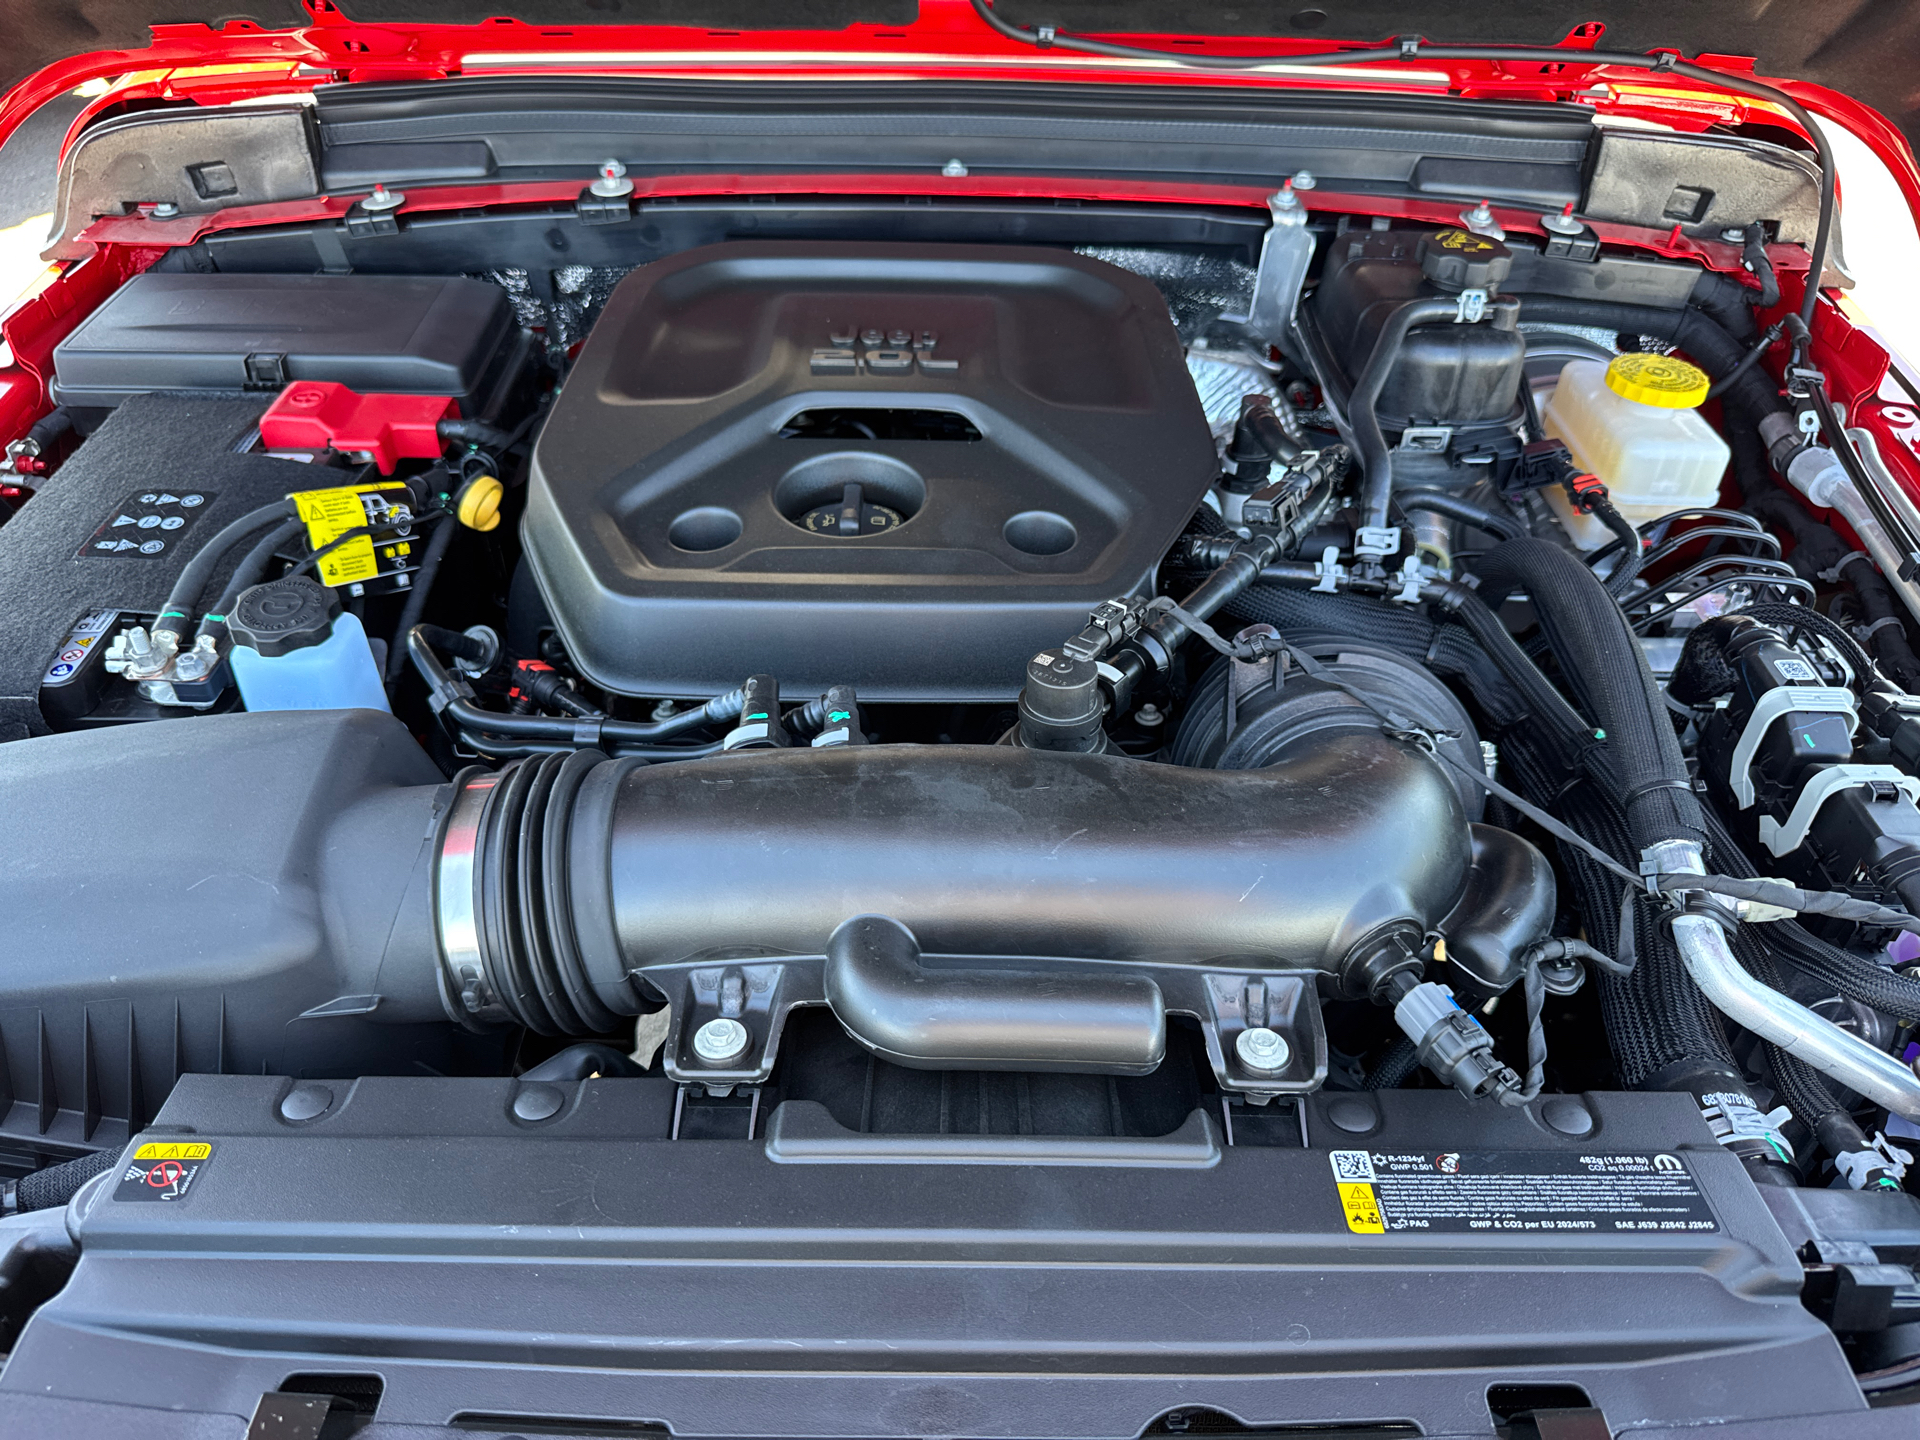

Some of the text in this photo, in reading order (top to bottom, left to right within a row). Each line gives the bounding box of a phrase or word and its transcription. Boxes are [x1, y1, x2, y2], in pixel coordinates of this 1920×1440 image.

[830, 327, 938, 349] Jeep
[810, 348, 959, 370] 2.0L
[1701, 1092, 1757, 1108] 680781AD
[1387, 1155, 1425, 1163] R-1234yf
[1579, 1156, 1649, 1165] 482g (1.060 lb)
[1409, 1220, 1430, 1228] PAG
[1524, 1222, 1539, 1230] per
[1614, 1221, 1714, 1229] SAE J639 J2842 J2845
